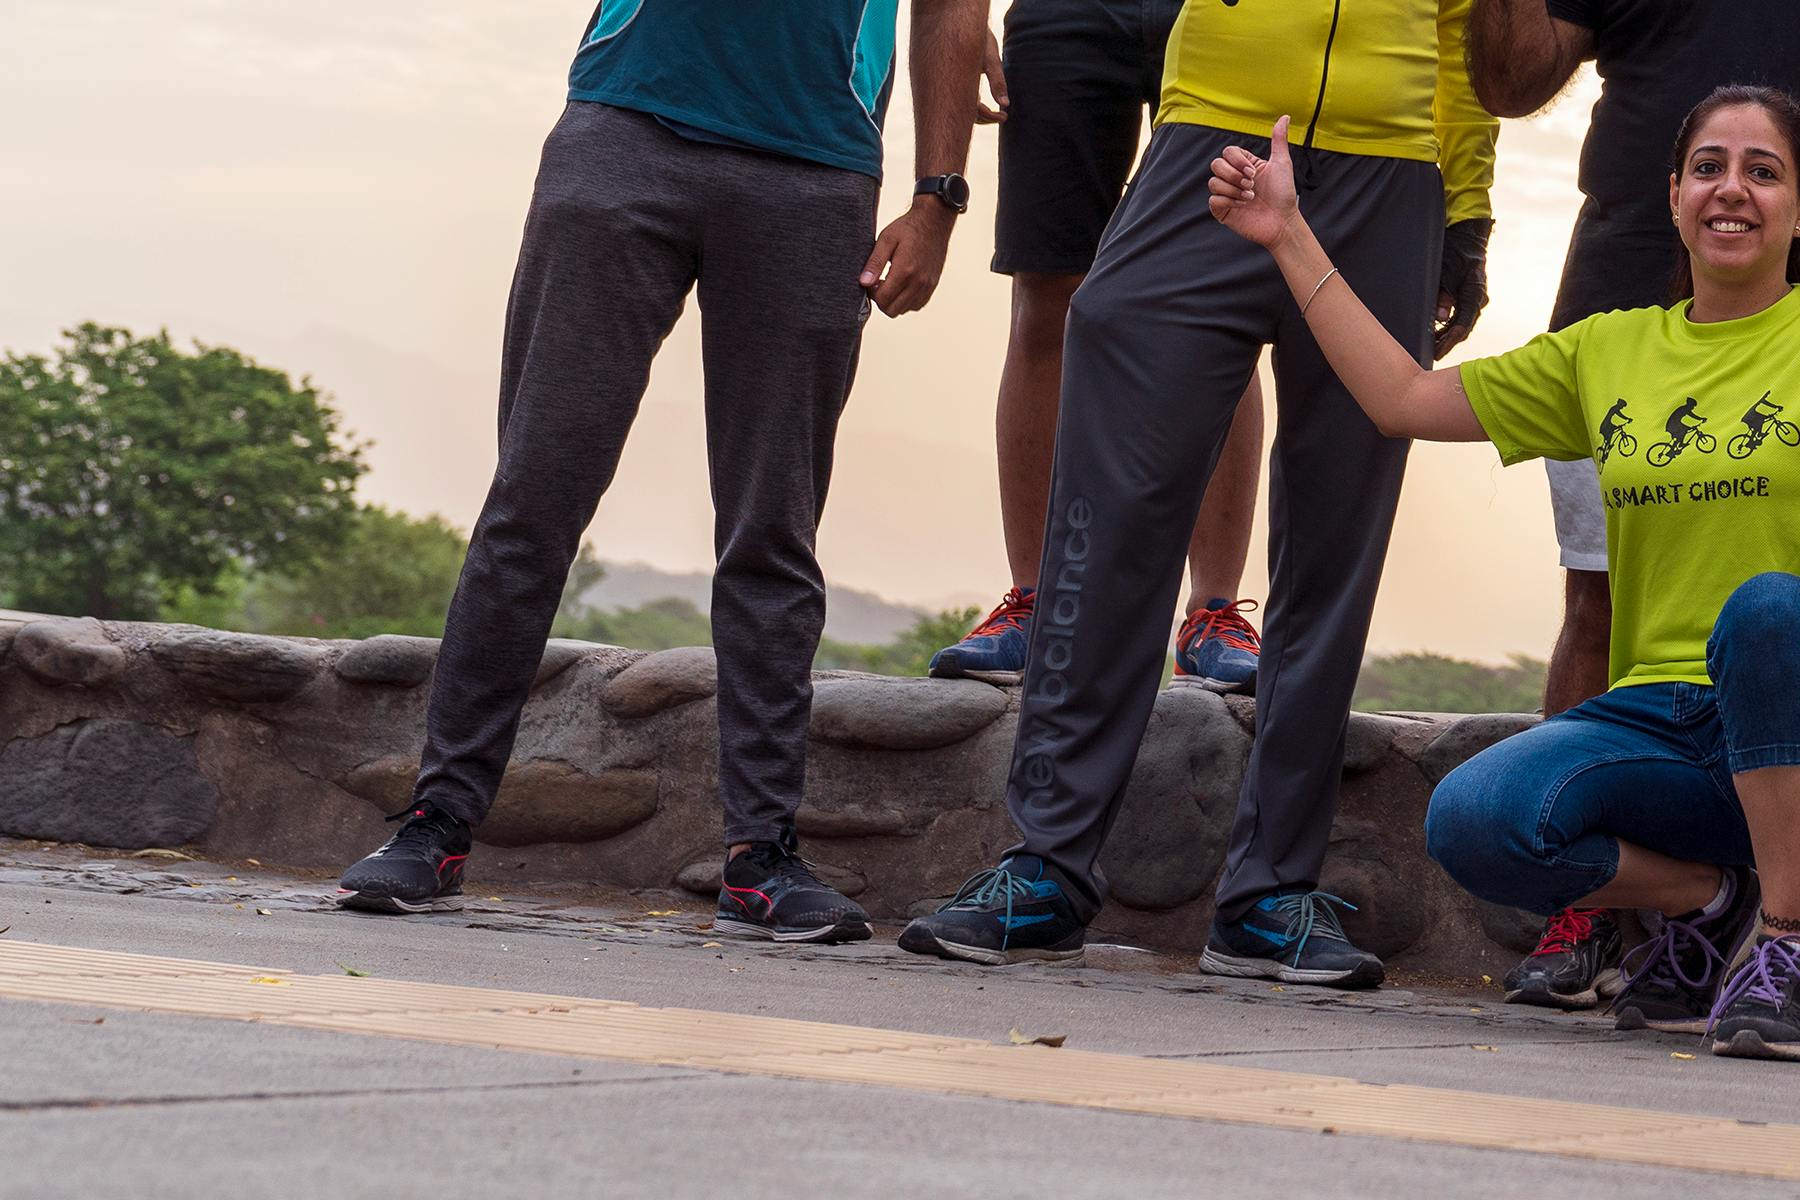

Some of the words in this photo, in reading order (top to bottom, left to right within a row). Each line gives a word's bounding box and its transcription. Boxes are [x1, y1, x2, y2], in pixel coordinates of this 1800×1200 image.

[1612, 483, 1684, 509] SMART
[1689, 476, 1770, 502] CHOICE
[1031, 496, 1094, 705] balance
[1023, 720, 1063, 818] new
